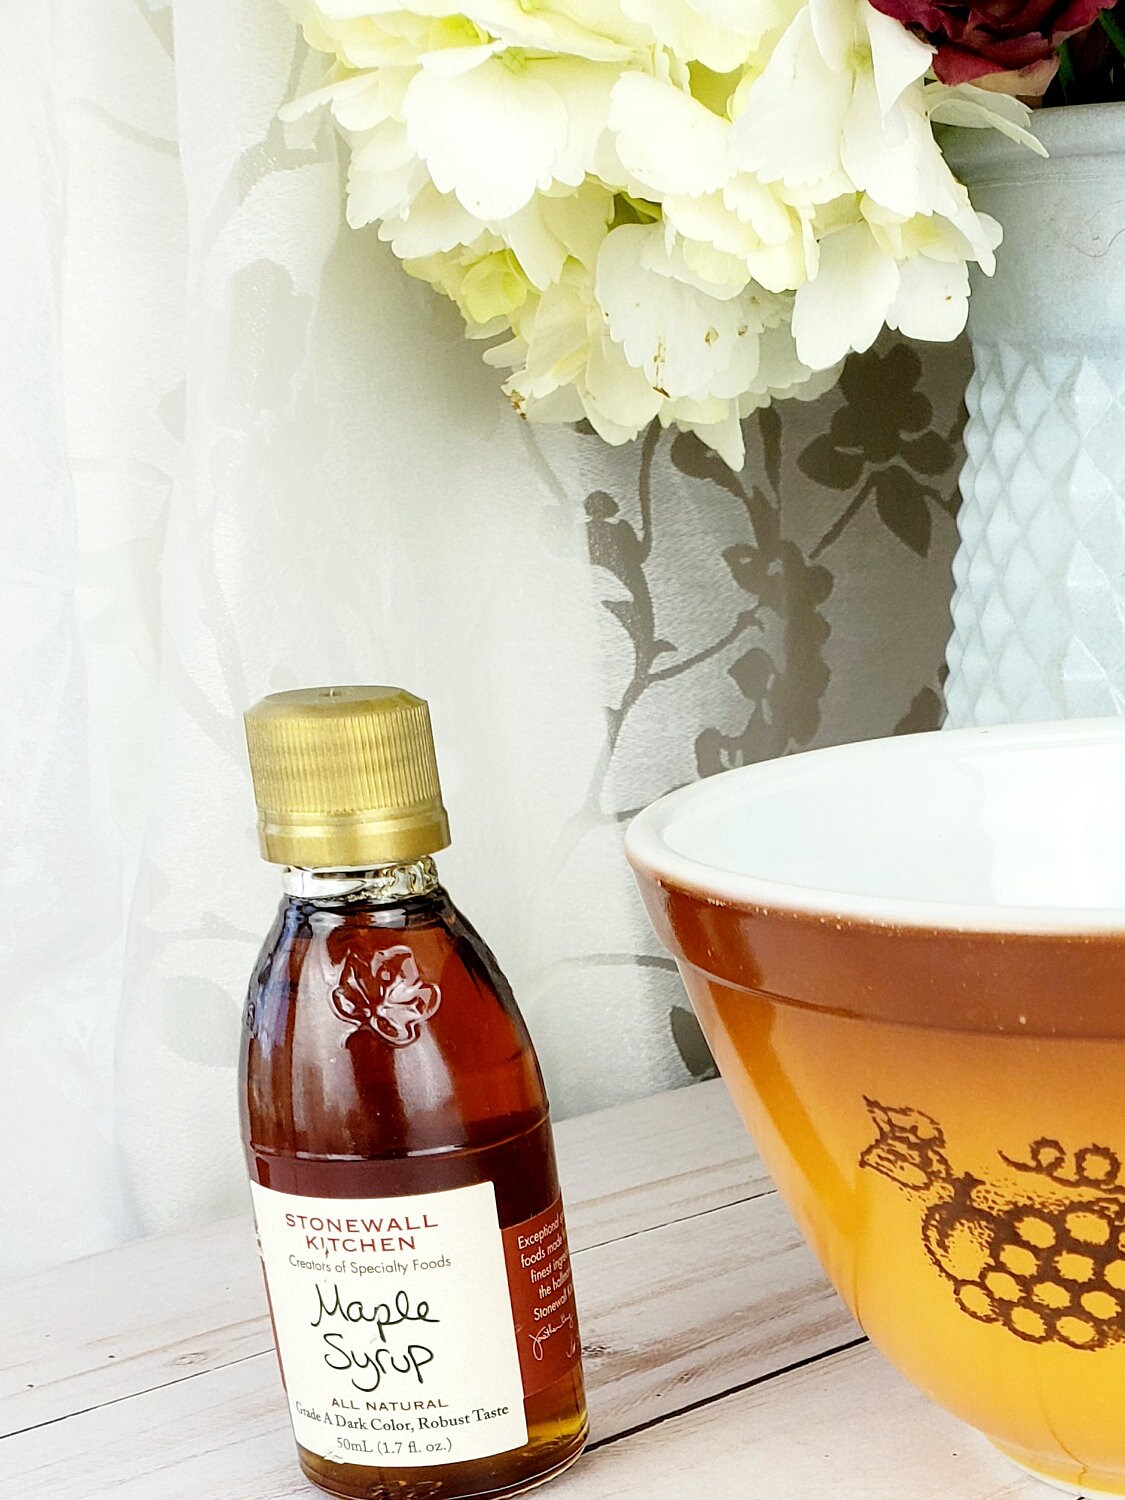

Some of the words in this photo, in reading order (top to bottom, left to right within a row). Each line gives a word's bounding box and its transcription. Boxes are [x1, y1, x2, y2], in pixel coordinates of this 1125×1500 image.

[285, 1213, 439, 1233] STONEWALL
[517, 1216, 560, 1249] Exceptional
[306, 1235, 416, 1253] KITCHEN
[520, 1247, 546, 1268] foods
[547, 1234, 563, 1255] made
[288, 1254, 331, 1272] Creators
[335, 1260, 346, 1273] of
[350, 1260, 408, 1277] Specialty
[412, 1254, 452, 1271] Foods
[530, 1265, 552, 1283] finest
[538, 1283, 552, 1299] the
[310, 1283, 441, 1343] Maple
[534, 1288, 568, 1321] Stonewall
[323, 1333, 434, 1392] Syrup
[331, 1398, 360, 1410] ALL
[366, 1397, 450, 1412] NATURAL
[295, 1400, 322, 1423] Grade
[323, 1412, 335, 1425] A
[335, 1415, 368, 1430] Dark
[370, 1418, 415, 1433] Color,
[418, 1414, 471, 1430] Robust
[471, 1404, 509, 1423] Taste
[336, 1437, 373, 1454] 50mL
[377, 1440, 402, 1457] (1.7
[406, 1439, 422, 1454] fl.
[425, 1437, 452, 1454] oz.)
